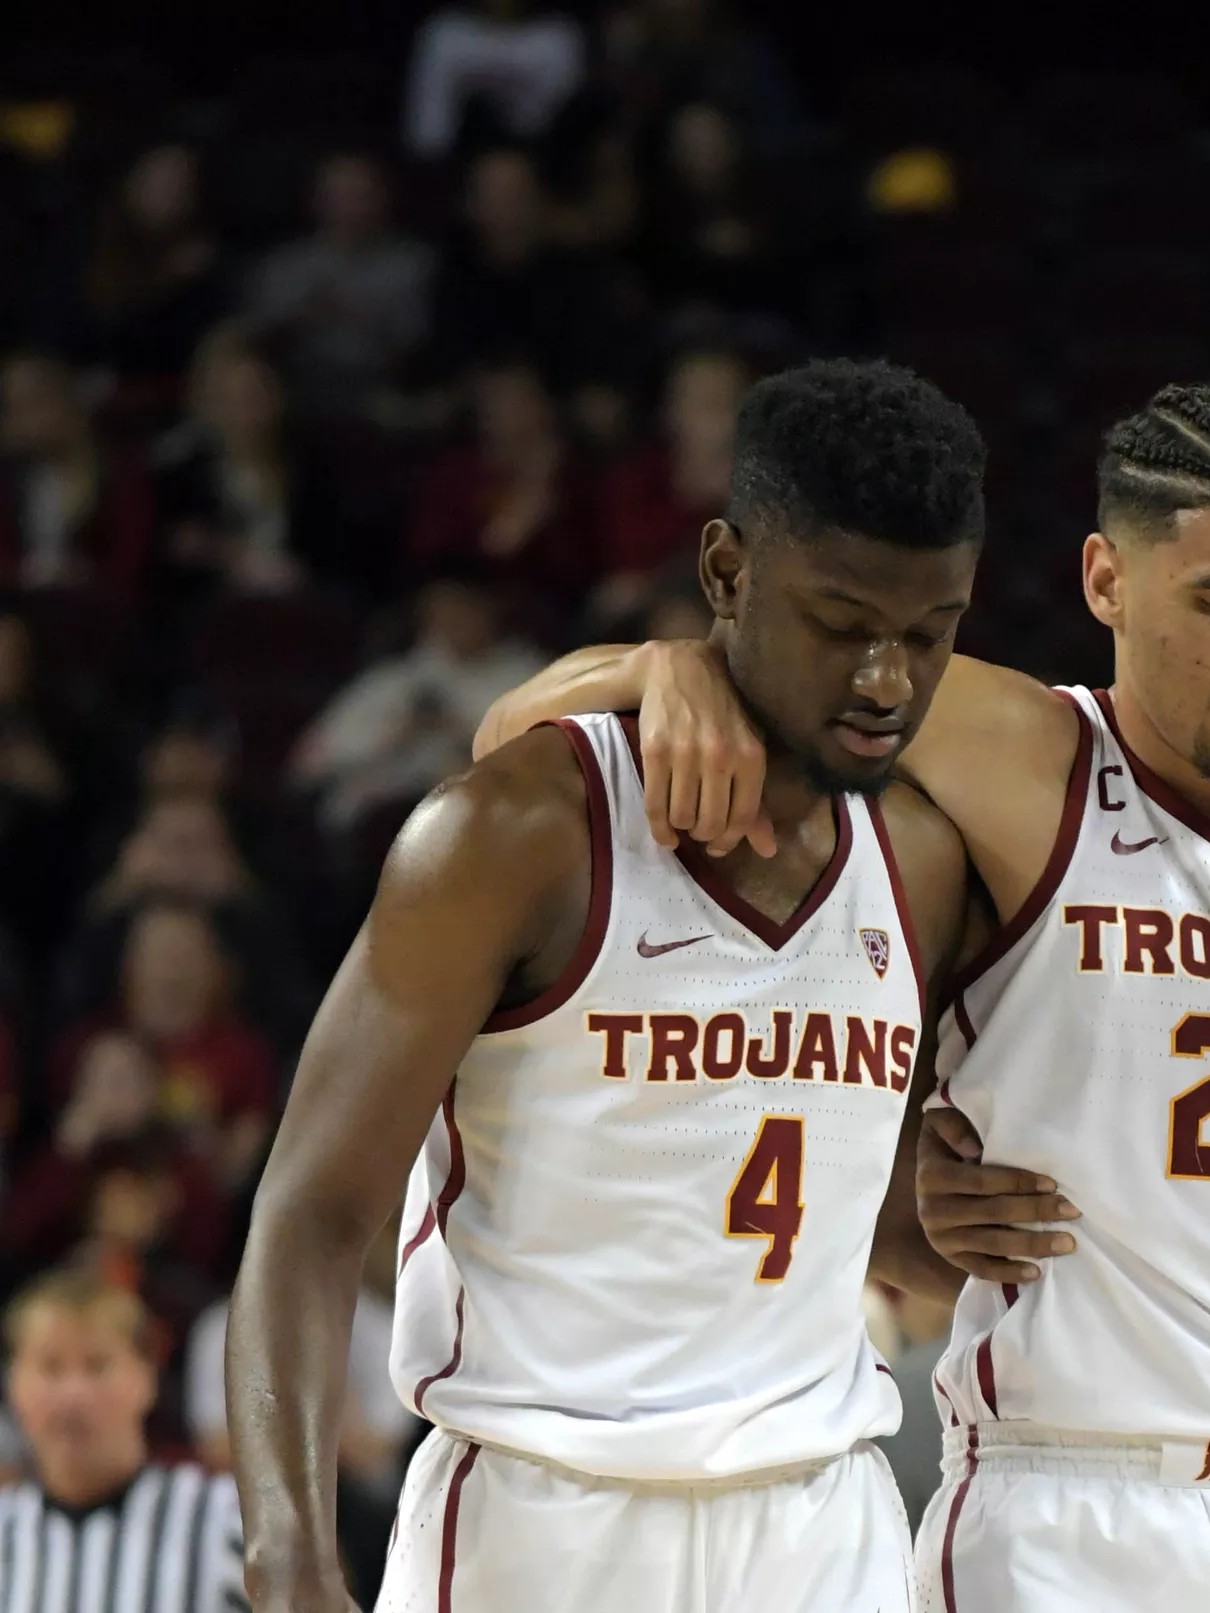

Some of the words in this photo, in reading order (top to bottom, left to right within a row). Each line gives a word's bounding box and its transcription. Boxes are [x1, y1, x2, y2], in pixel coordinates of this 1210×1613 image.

[1097, 765, 1126, 811] C
[584, 1009, 918, 1095] TROJANS
[724, 1113, 806, 1284] 4
